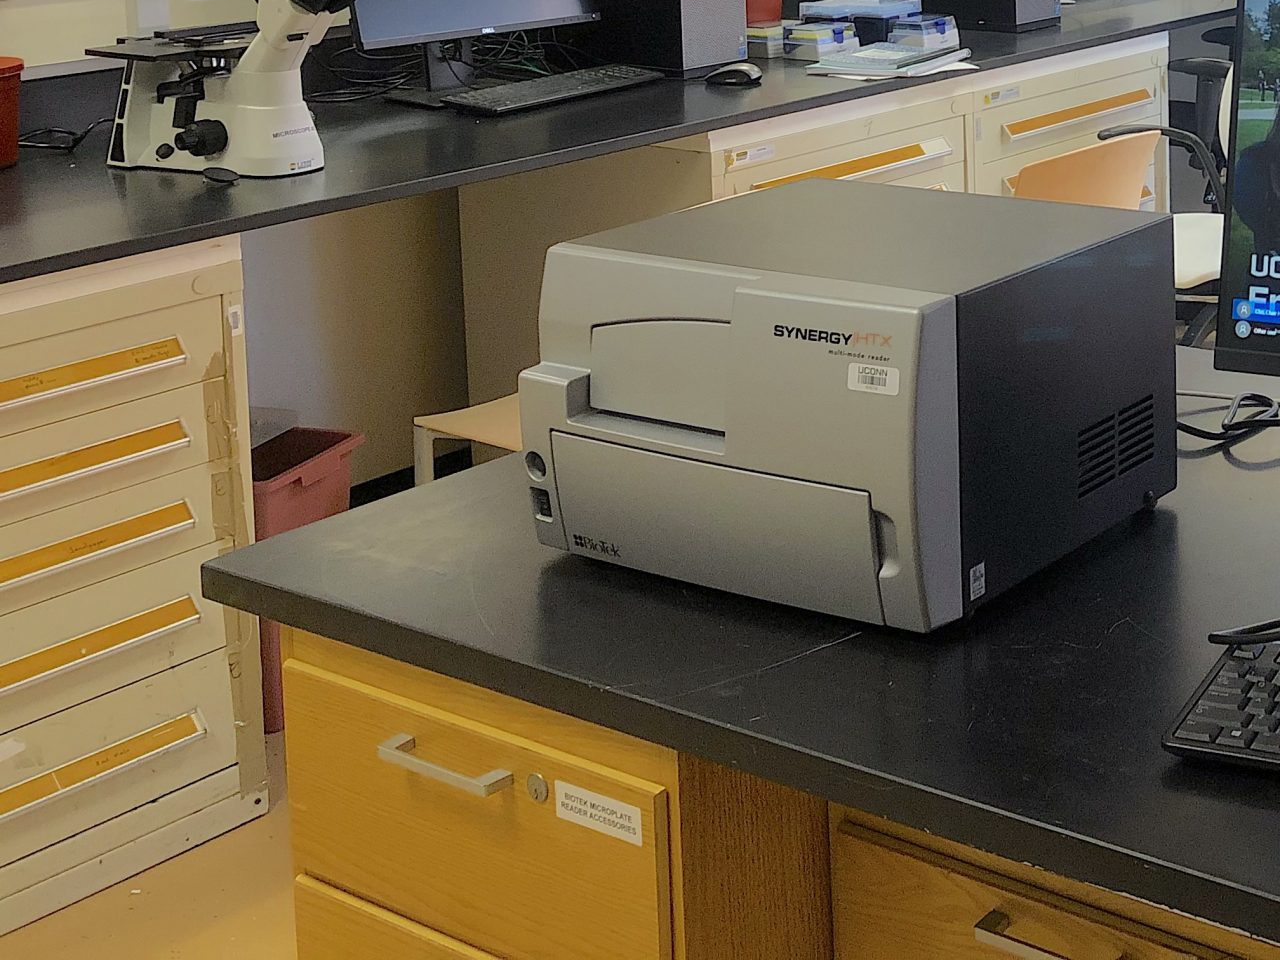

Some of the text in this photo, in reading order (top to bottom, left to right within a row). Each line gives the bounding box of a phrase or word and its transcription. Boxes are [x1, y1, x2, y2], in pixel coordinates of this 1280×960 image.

[773, 324, 853, 346] SYNERGY
[828, 349, 891, 362] multi-mode reader
[857, 365, 888, 377] UCONN
[583, 536, 622, 558] BioTek
[560, 800, 637, 836] READER ACCESSORIES
[564, 792, 633, 824] BIOTEK MICROPLATE
